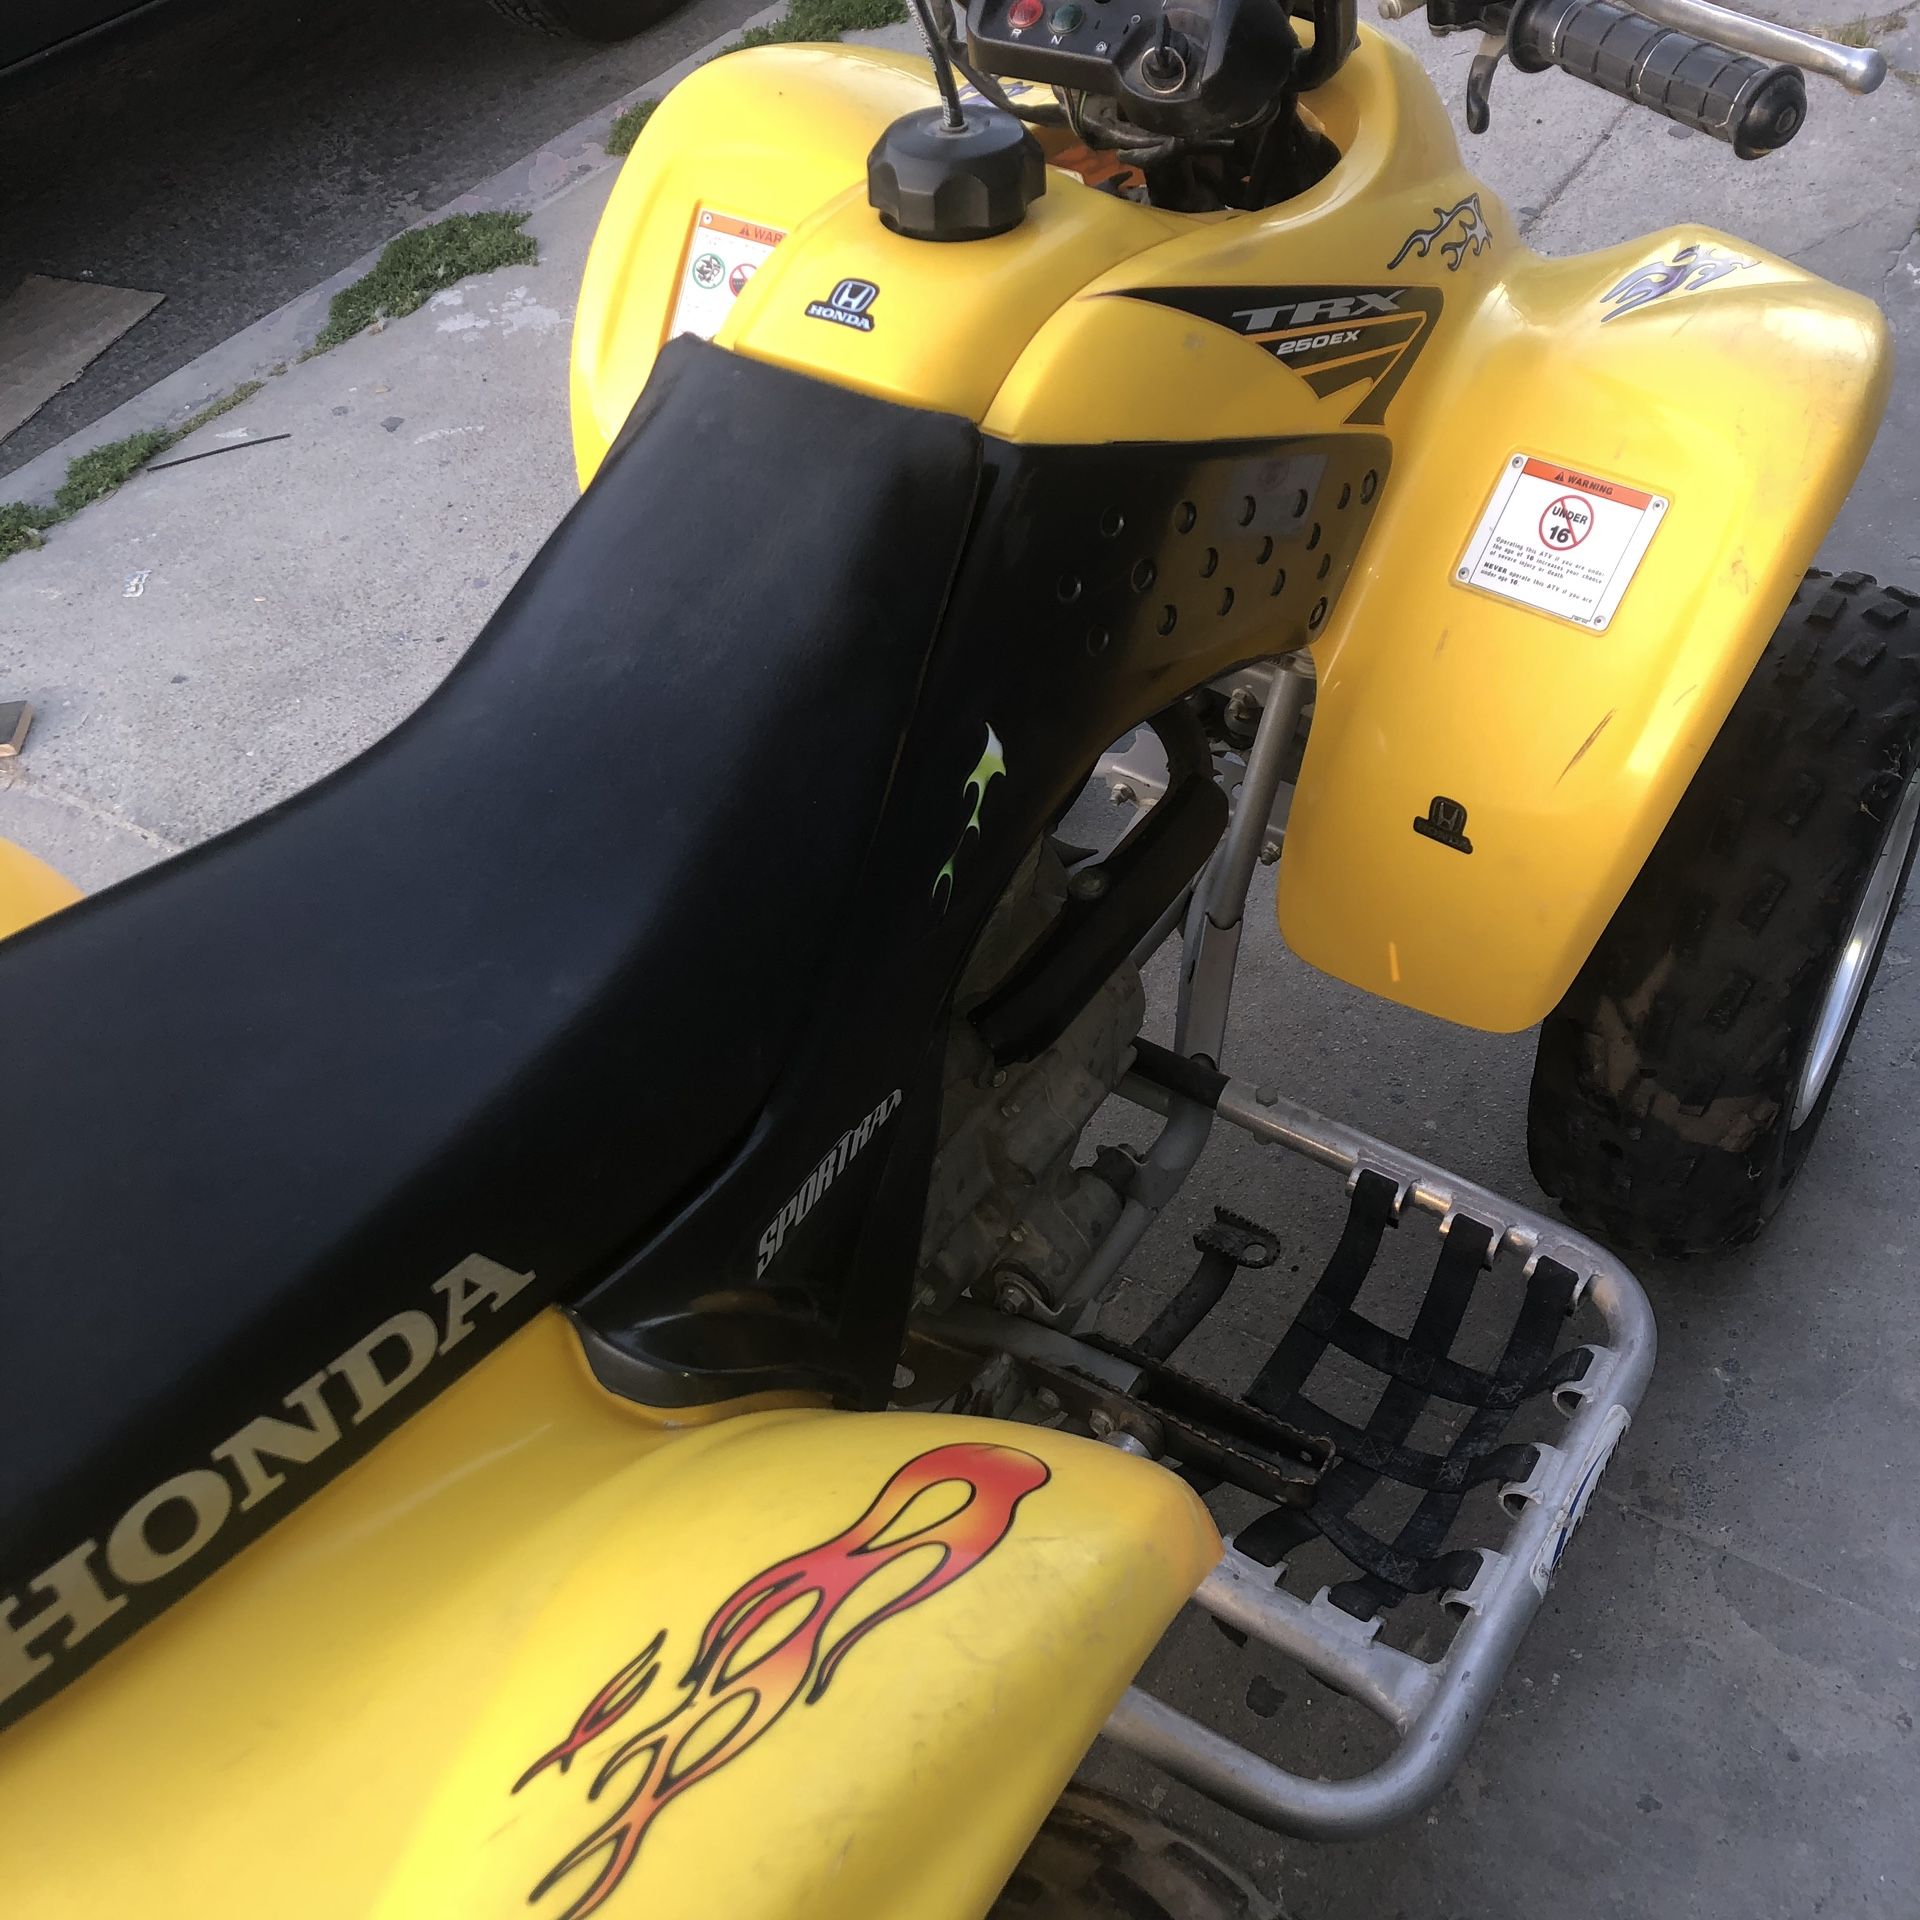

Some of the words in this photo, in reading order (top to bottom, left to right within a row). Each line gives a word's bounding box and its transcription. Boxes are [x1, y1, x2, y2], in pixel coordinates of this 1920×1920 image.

[1011, 28, 1023, 39] R
[1050, 34, 1064, 46] N
[754, 227, 783, 243] WAR
[808, 303, 871, 331] HONDA
[1232, 289, 1407, 331] TRX
[1276, 329, 1362, 356] 250EX
[1567, 475, 1614, 495] WARNING
[1552, 506, 1589, 525] UNDER
[1549, 525, 1571, 543] 16
[1496, 536, 1524, 551] Operating
[1539, 551, 1553, 559] ATV
[1484, 561, 1508, 574] NEVER
[0, 1252, 536, 1702] HONDA
